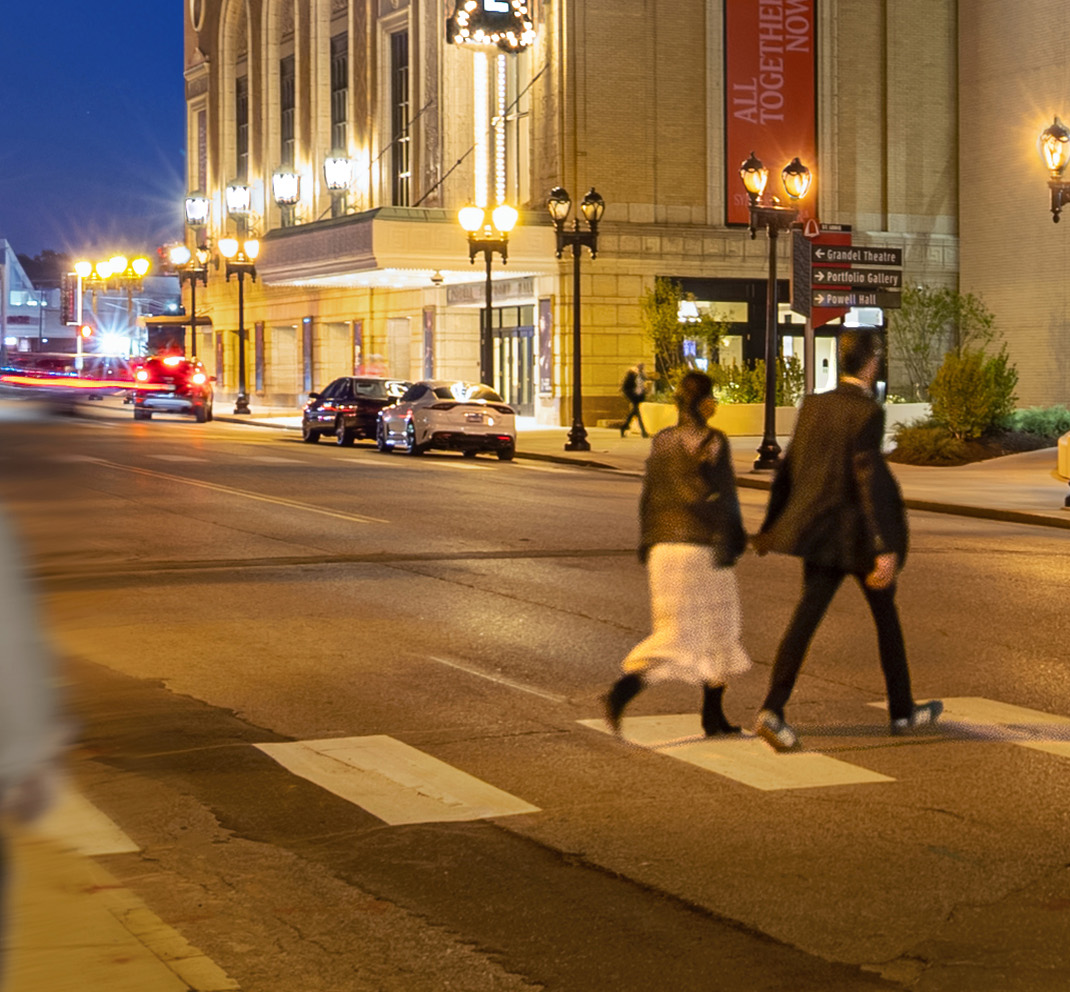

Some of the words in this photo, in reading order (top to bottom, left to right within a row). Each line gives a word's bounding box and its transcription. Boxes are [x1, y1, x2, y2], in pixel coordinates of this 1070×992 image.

[733, 77, 758, 125] ALL
[827, 249, 861, 261] Grandel
[863, 250, 897, 263] Theatre
[827, 271, 865, 283] Portfolio
[867, 272, 899, 286] Gallery
[827, 293, 857, 305] Powell
[858, 294, 877, 305] Hall
